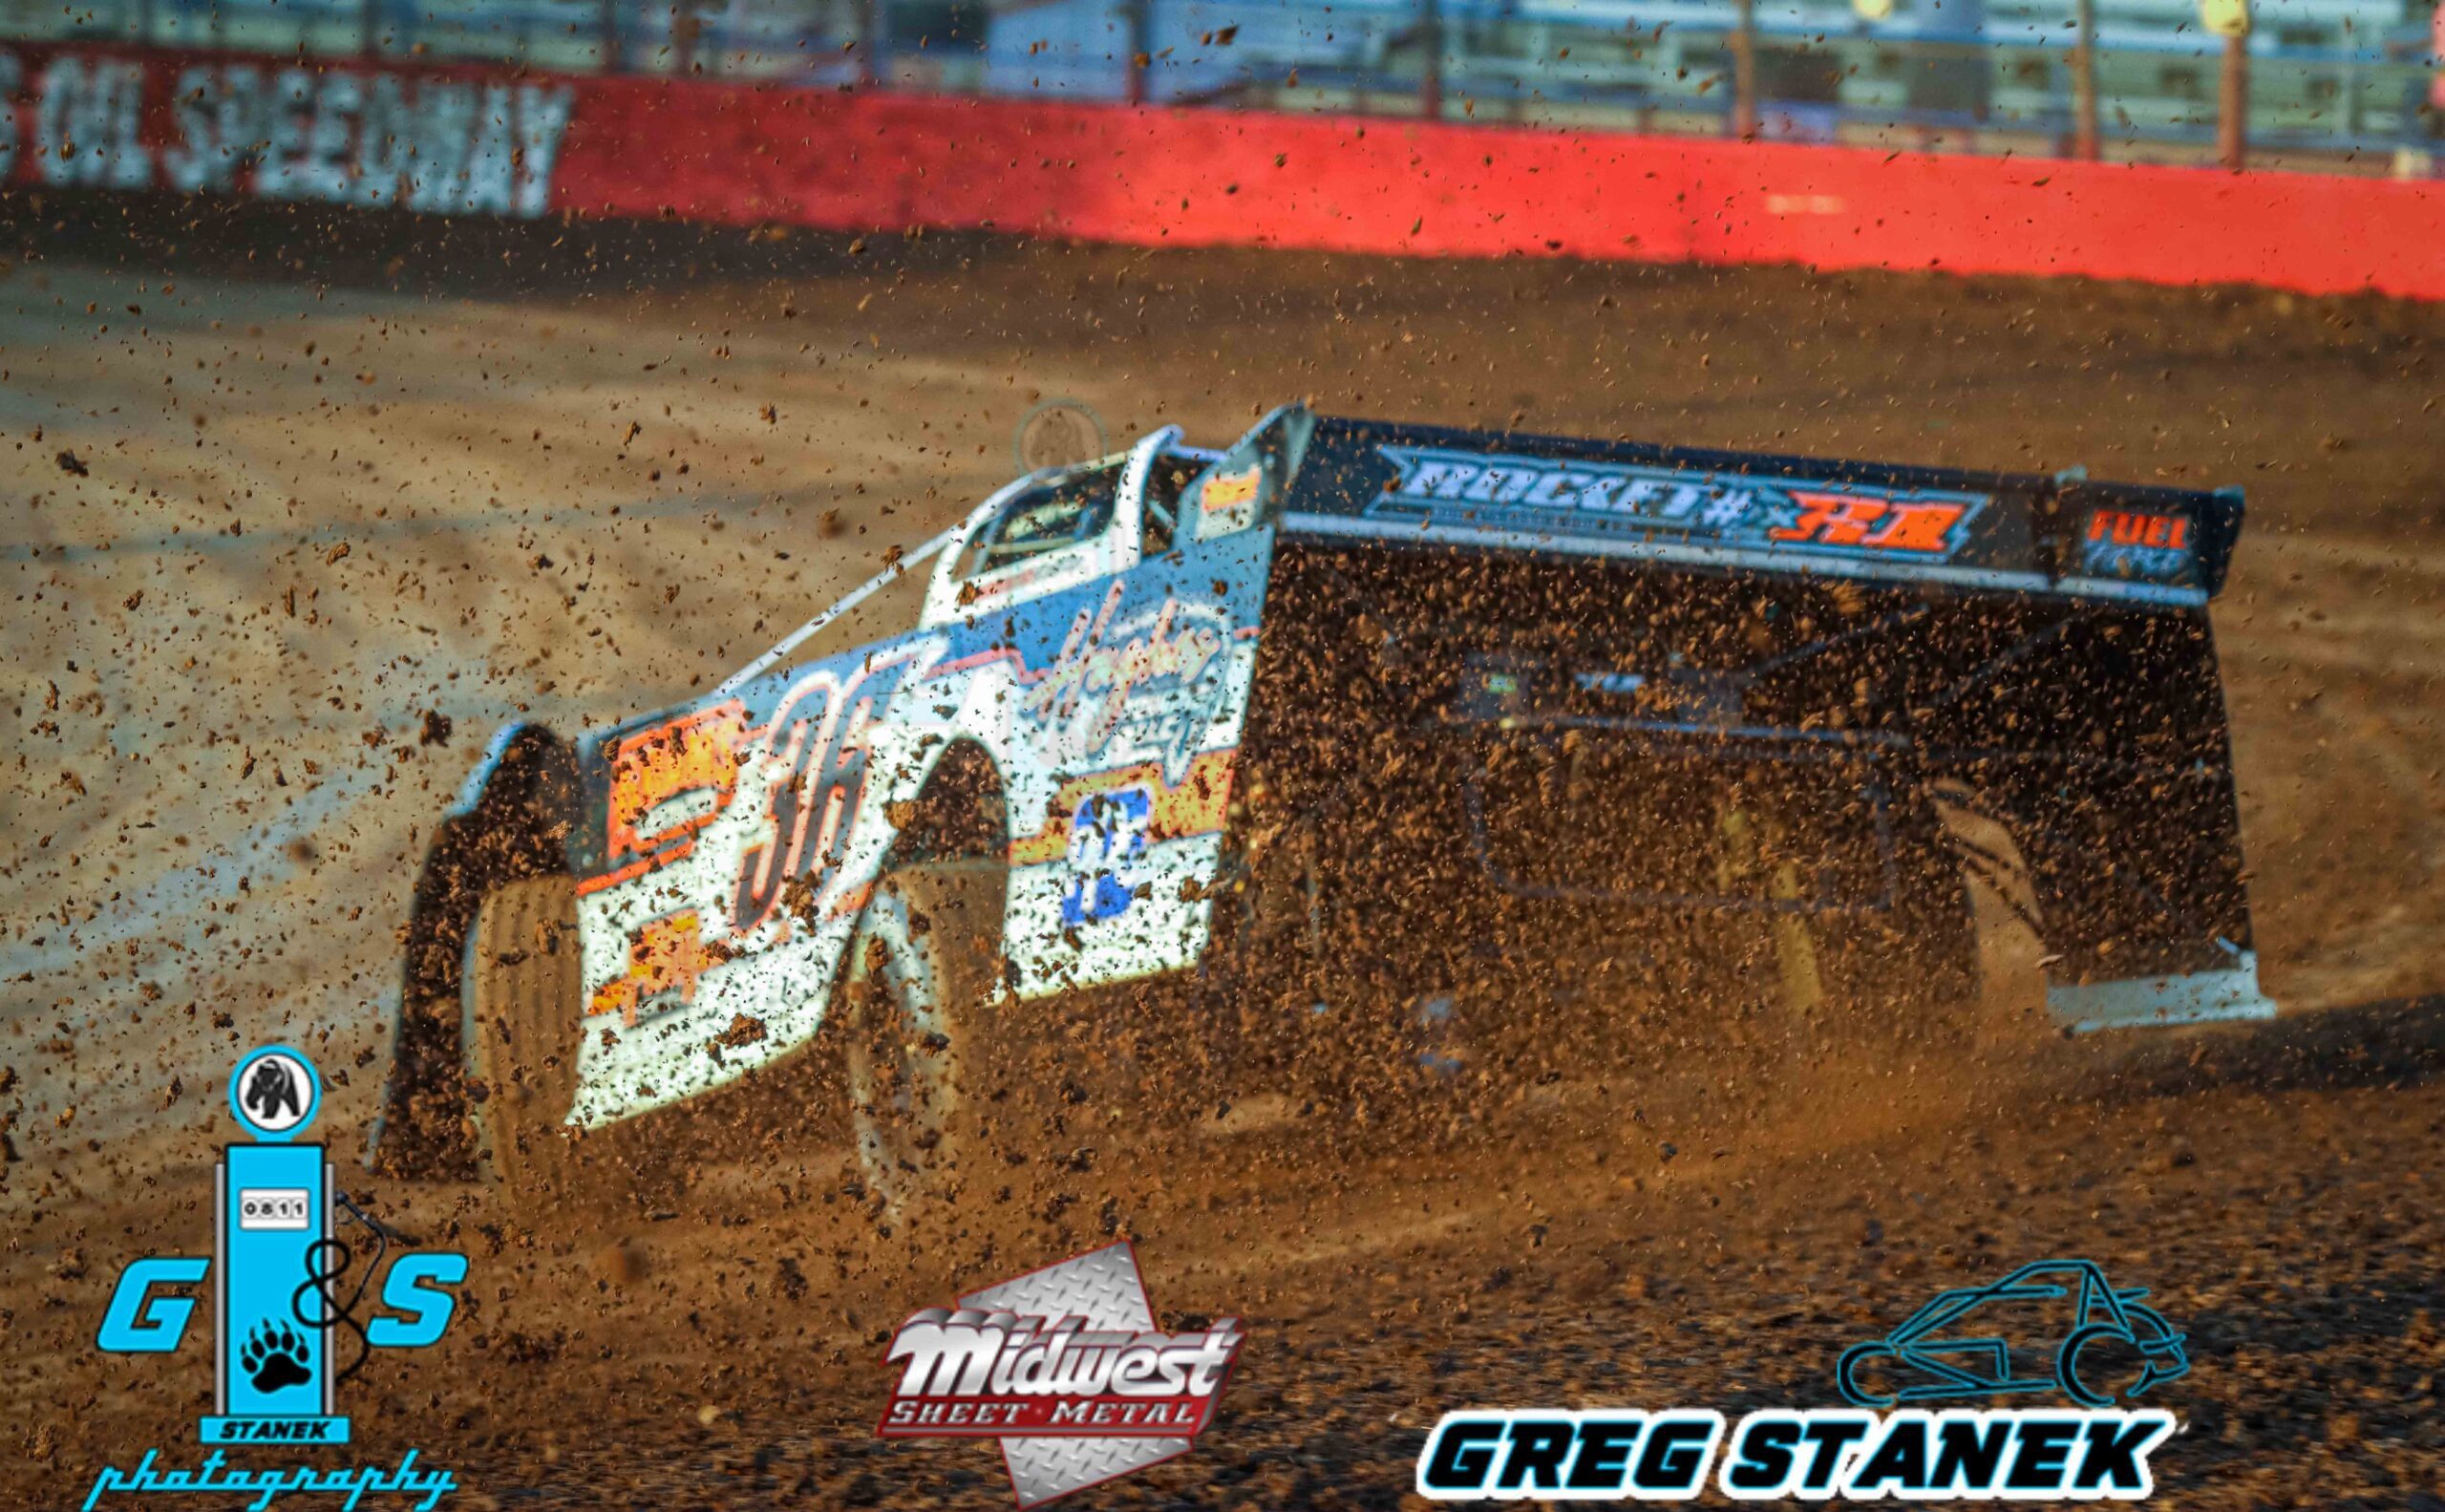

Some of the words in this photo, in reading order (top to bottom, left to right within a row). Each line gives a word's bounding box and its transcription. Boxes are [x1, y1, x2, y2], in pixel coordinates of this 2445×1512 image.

[163, 63, 575, 218] SPEEDWAY
[1400, 460, 1704, 521] ROCKET
[2086, 509, 2188, 549] FUEL
